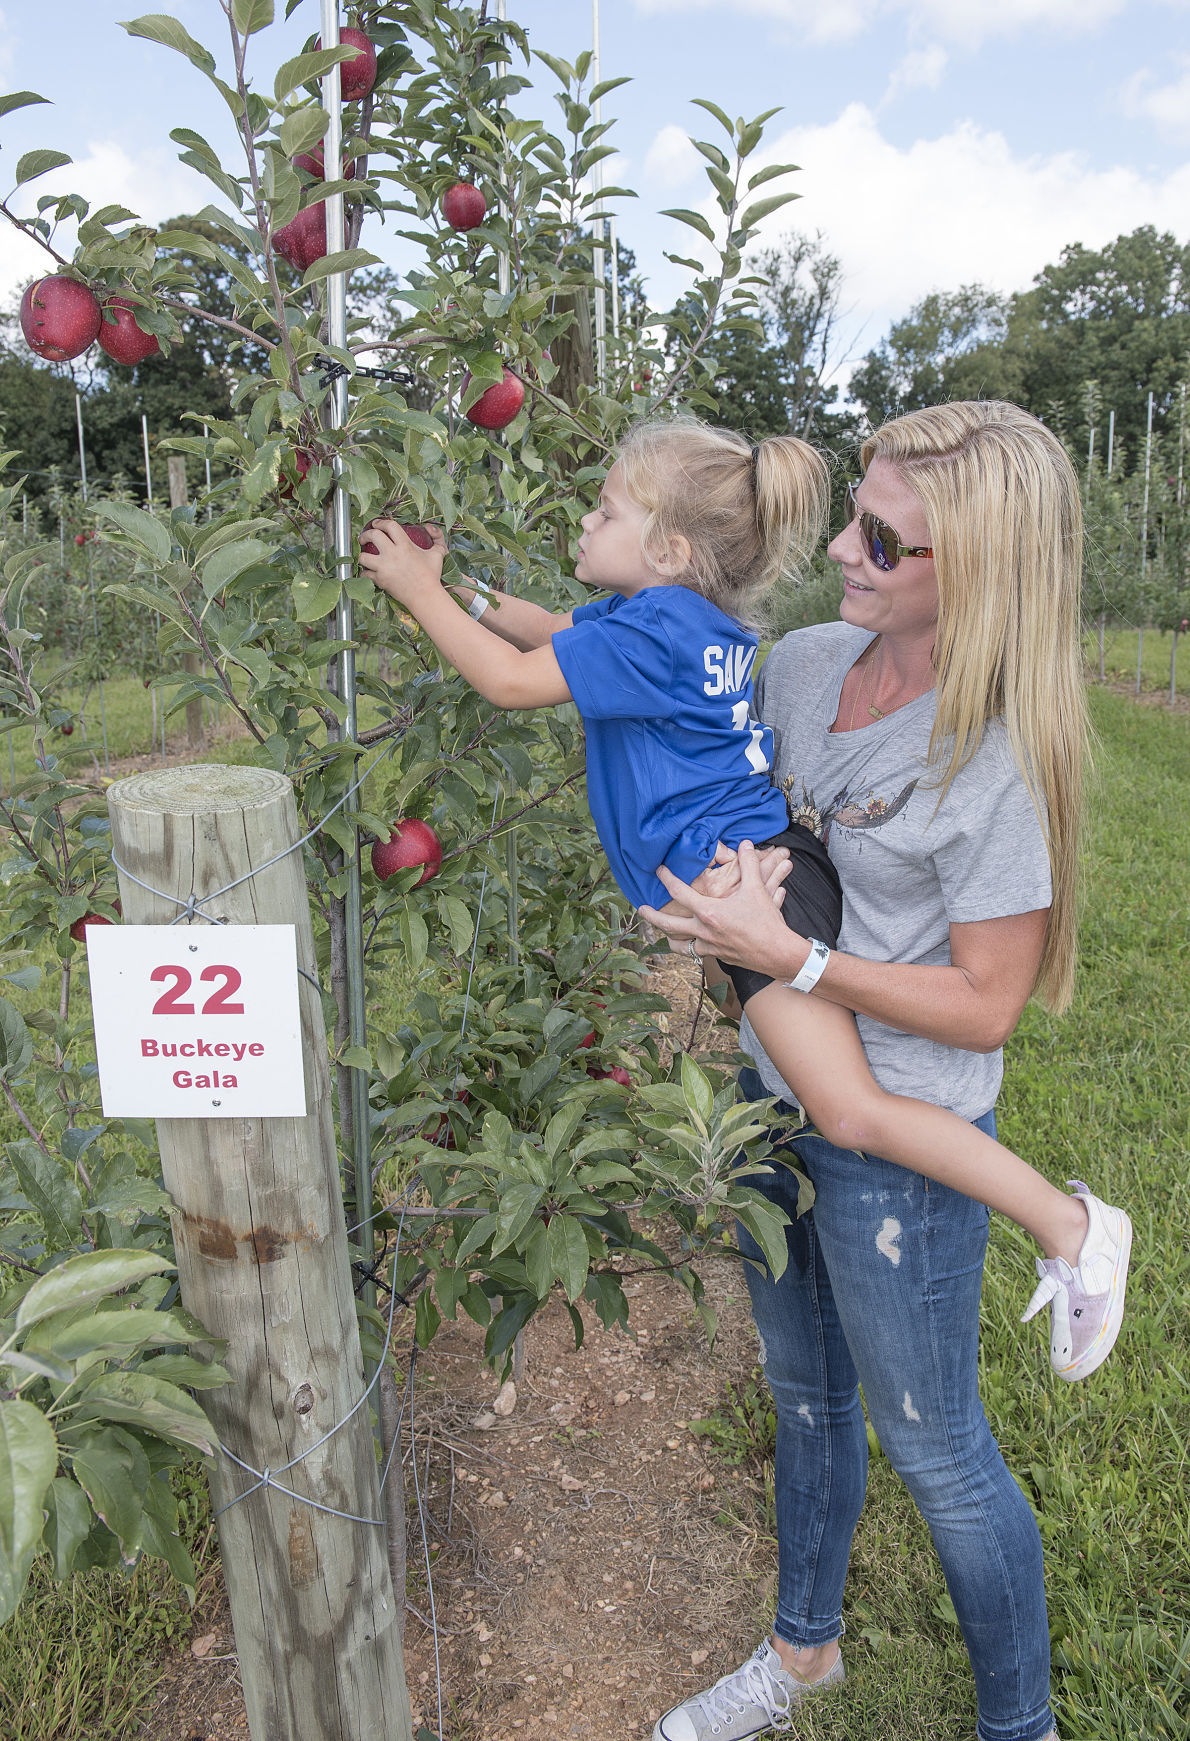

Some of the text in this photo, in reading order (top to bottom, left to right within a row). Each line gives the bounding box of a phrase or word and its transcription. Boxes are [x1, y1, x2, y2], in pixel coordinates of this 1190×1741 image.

[150, 964, 245, 1015] 22
[140, 1038, 265, 1062] Buckeye
[172, 1070, 238, 1089] Gala
